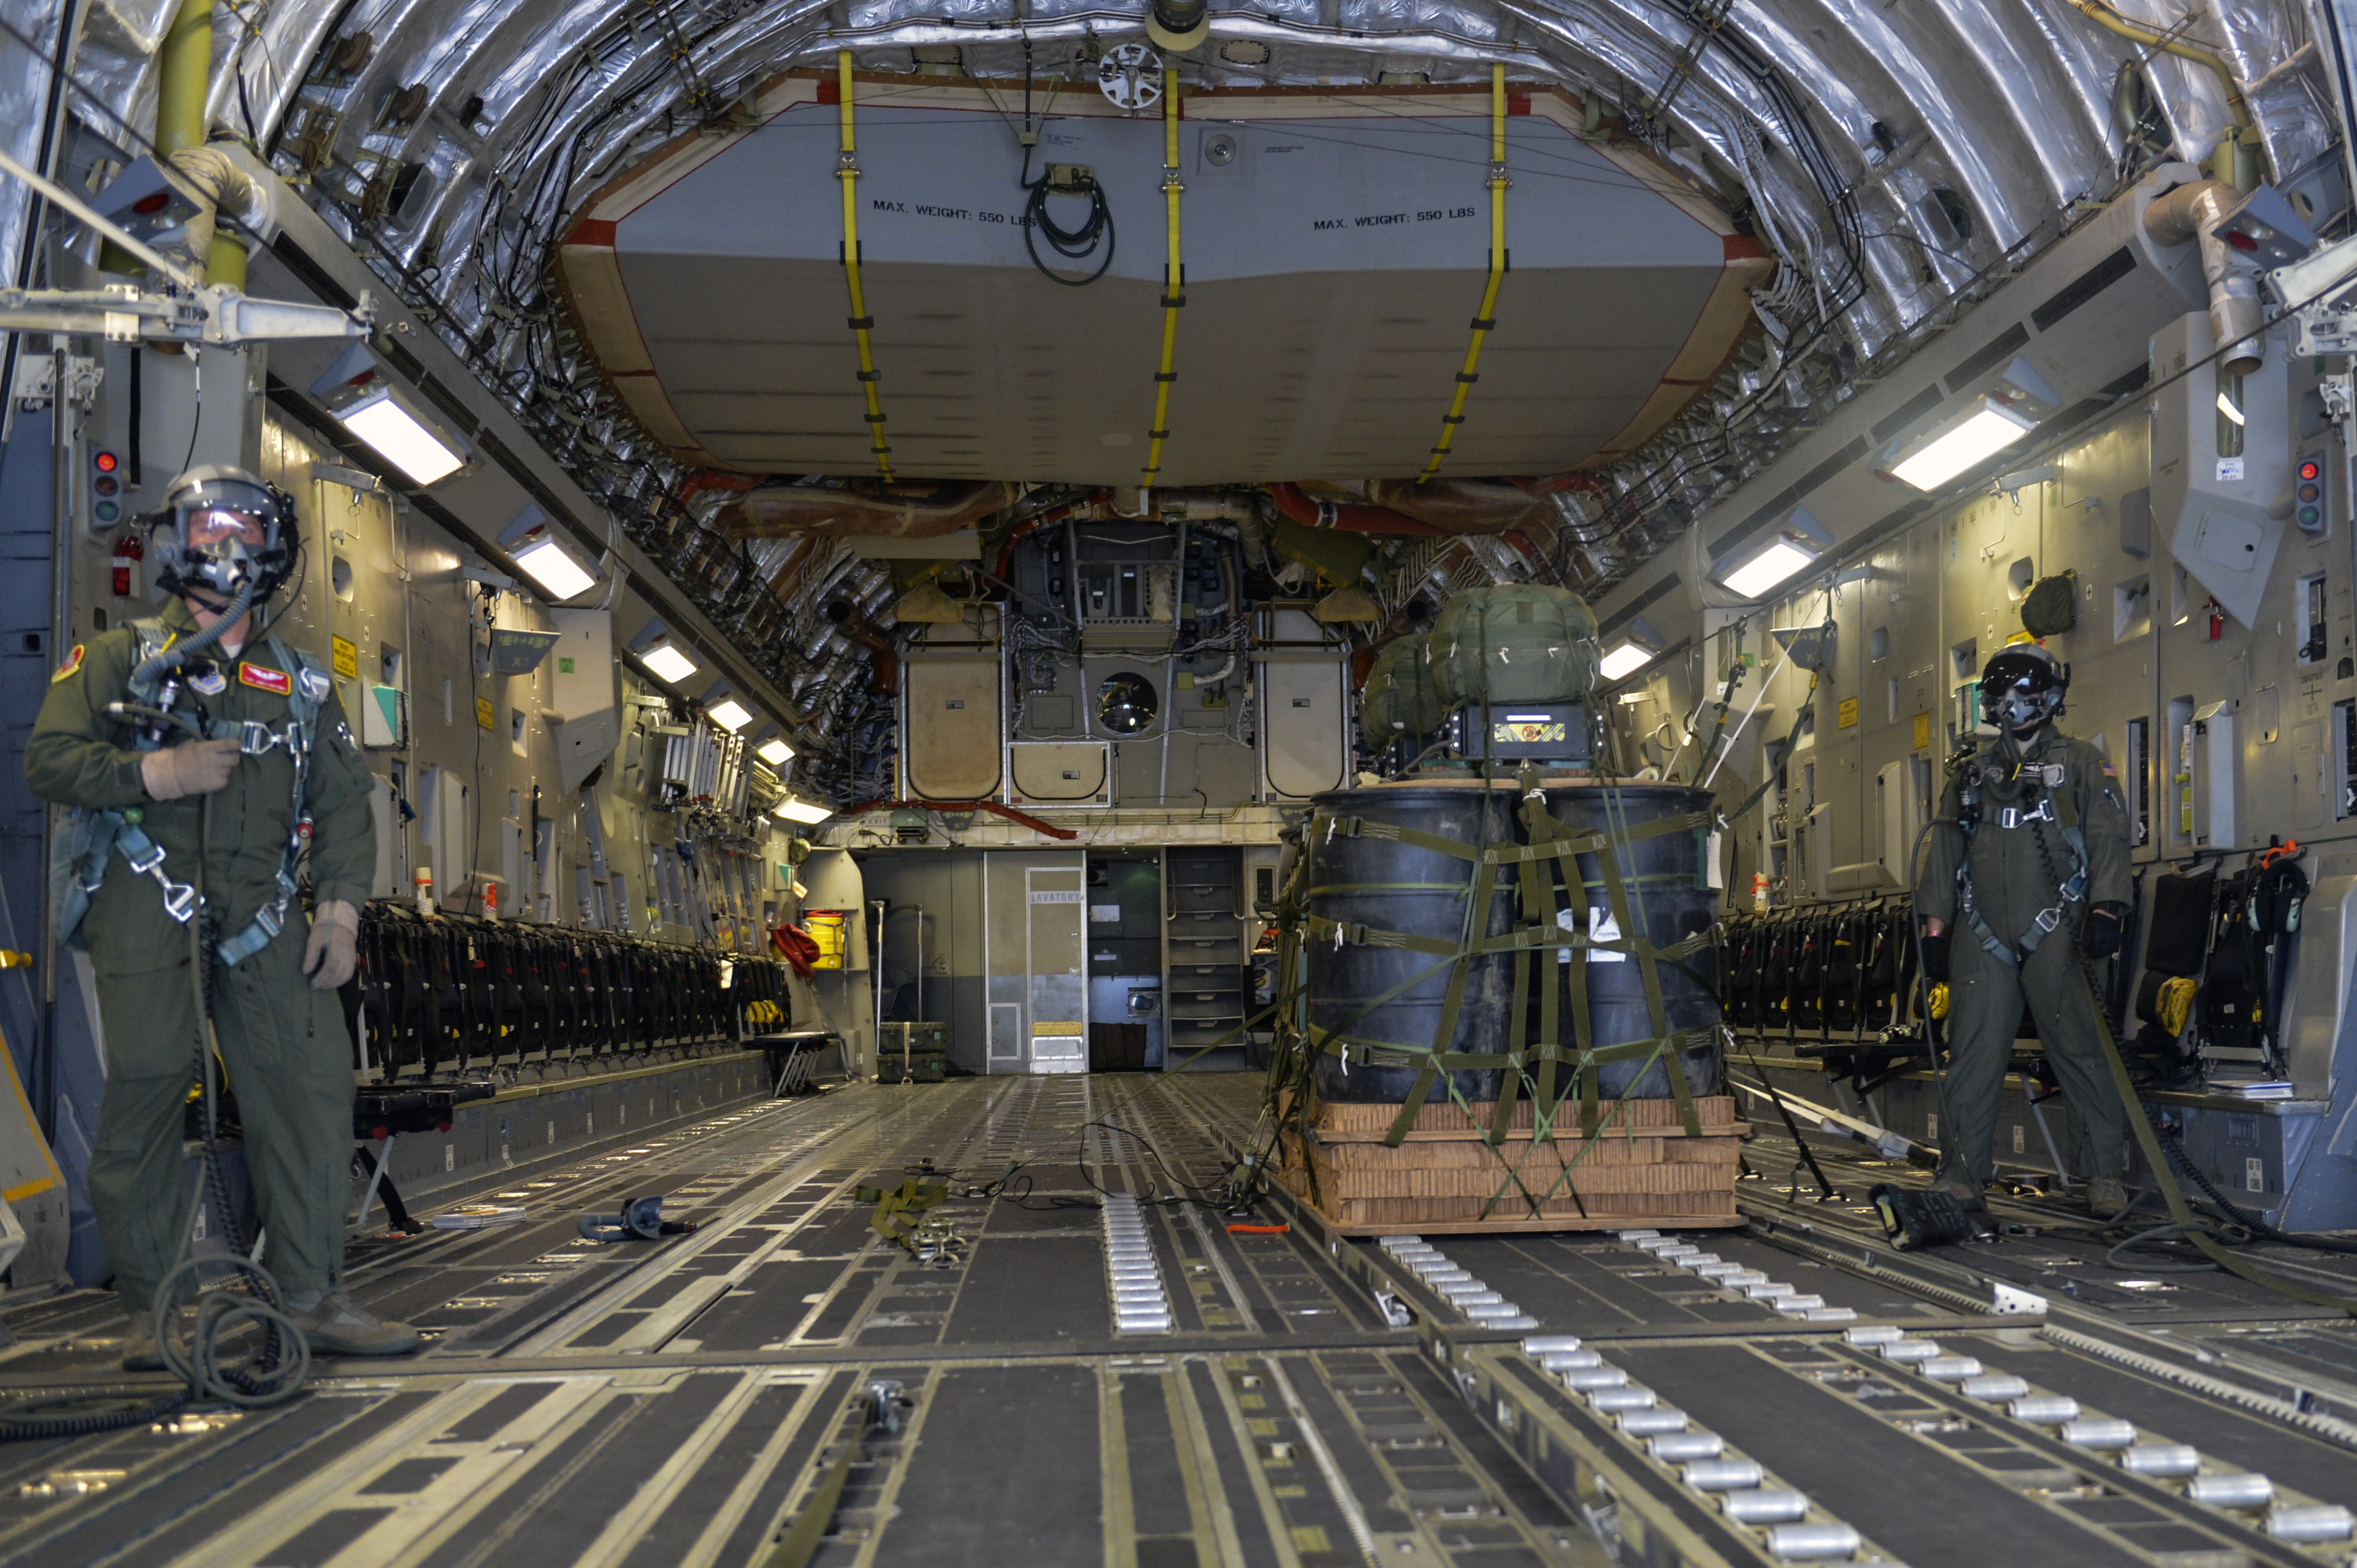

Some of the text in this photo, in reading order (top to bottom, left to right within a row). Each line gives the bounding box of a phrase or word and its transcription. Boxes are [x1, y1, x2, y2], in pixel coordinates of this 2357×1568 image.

[873, 200, 1037, 227] MAX. WEIGHT: 550 LBS
[1314, 207, 1475, 231] MAX. WEIGHT: 550 LBS
[1031, 893, 1079, 902] LAVATORY
